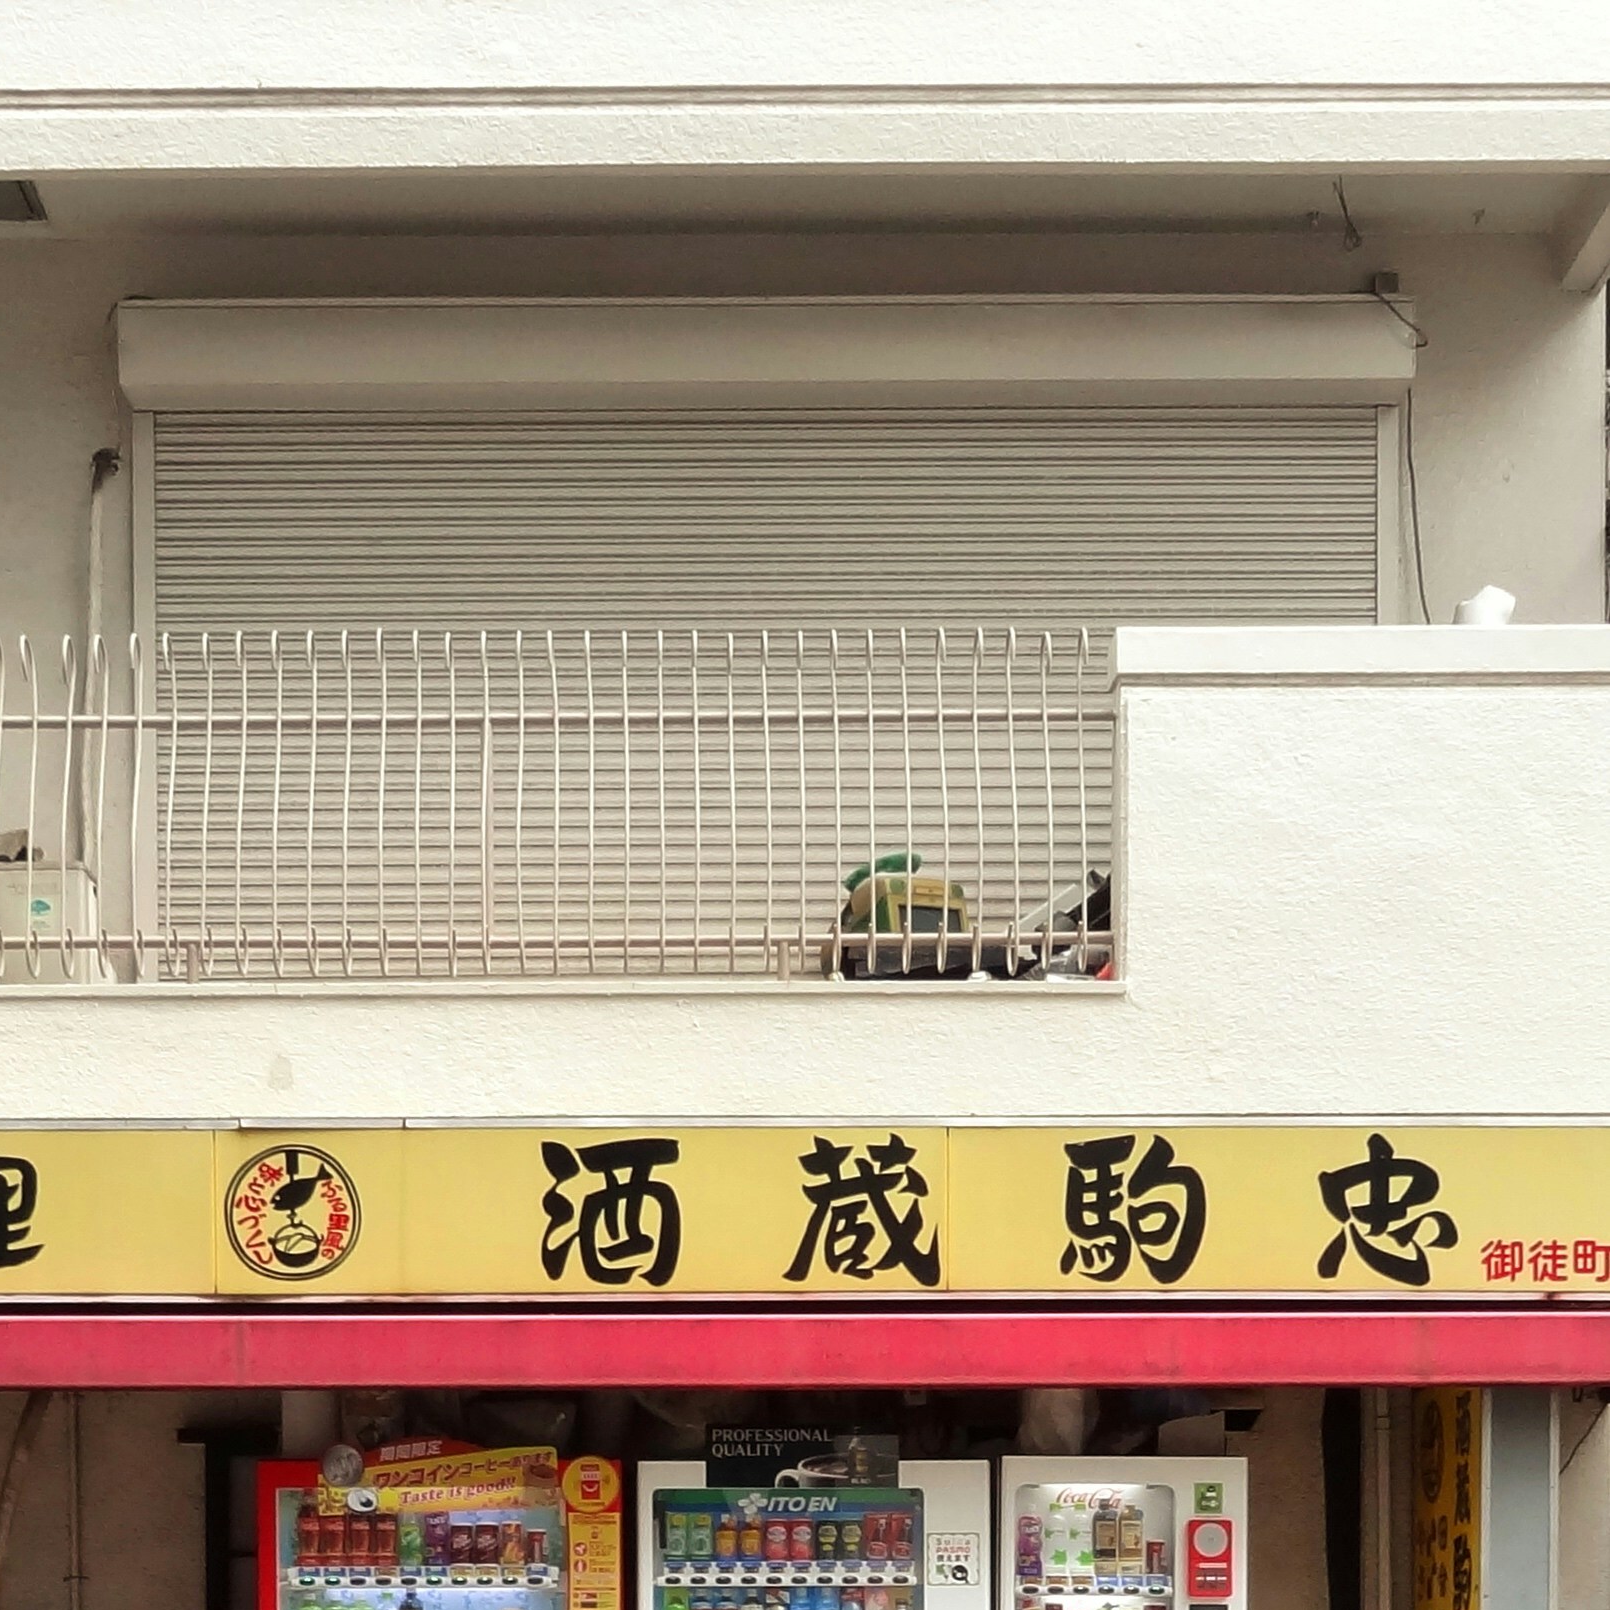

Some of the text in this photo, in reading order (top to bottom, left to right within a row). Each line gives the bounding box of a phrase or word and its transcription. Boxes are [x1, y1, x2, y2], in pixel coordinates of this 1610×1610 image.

[541, 1133, 1458, 1286] 酒蔵駒忠
[712, 1428, 833, 1442] PROFESSIONAL
[712, 1443, 784, 1458] QUALITY
[401, 1489, 444, 1504] Taste
[449, 1486, 463, 1498] is
[767, 1496, 838, 1511] ITO EN
